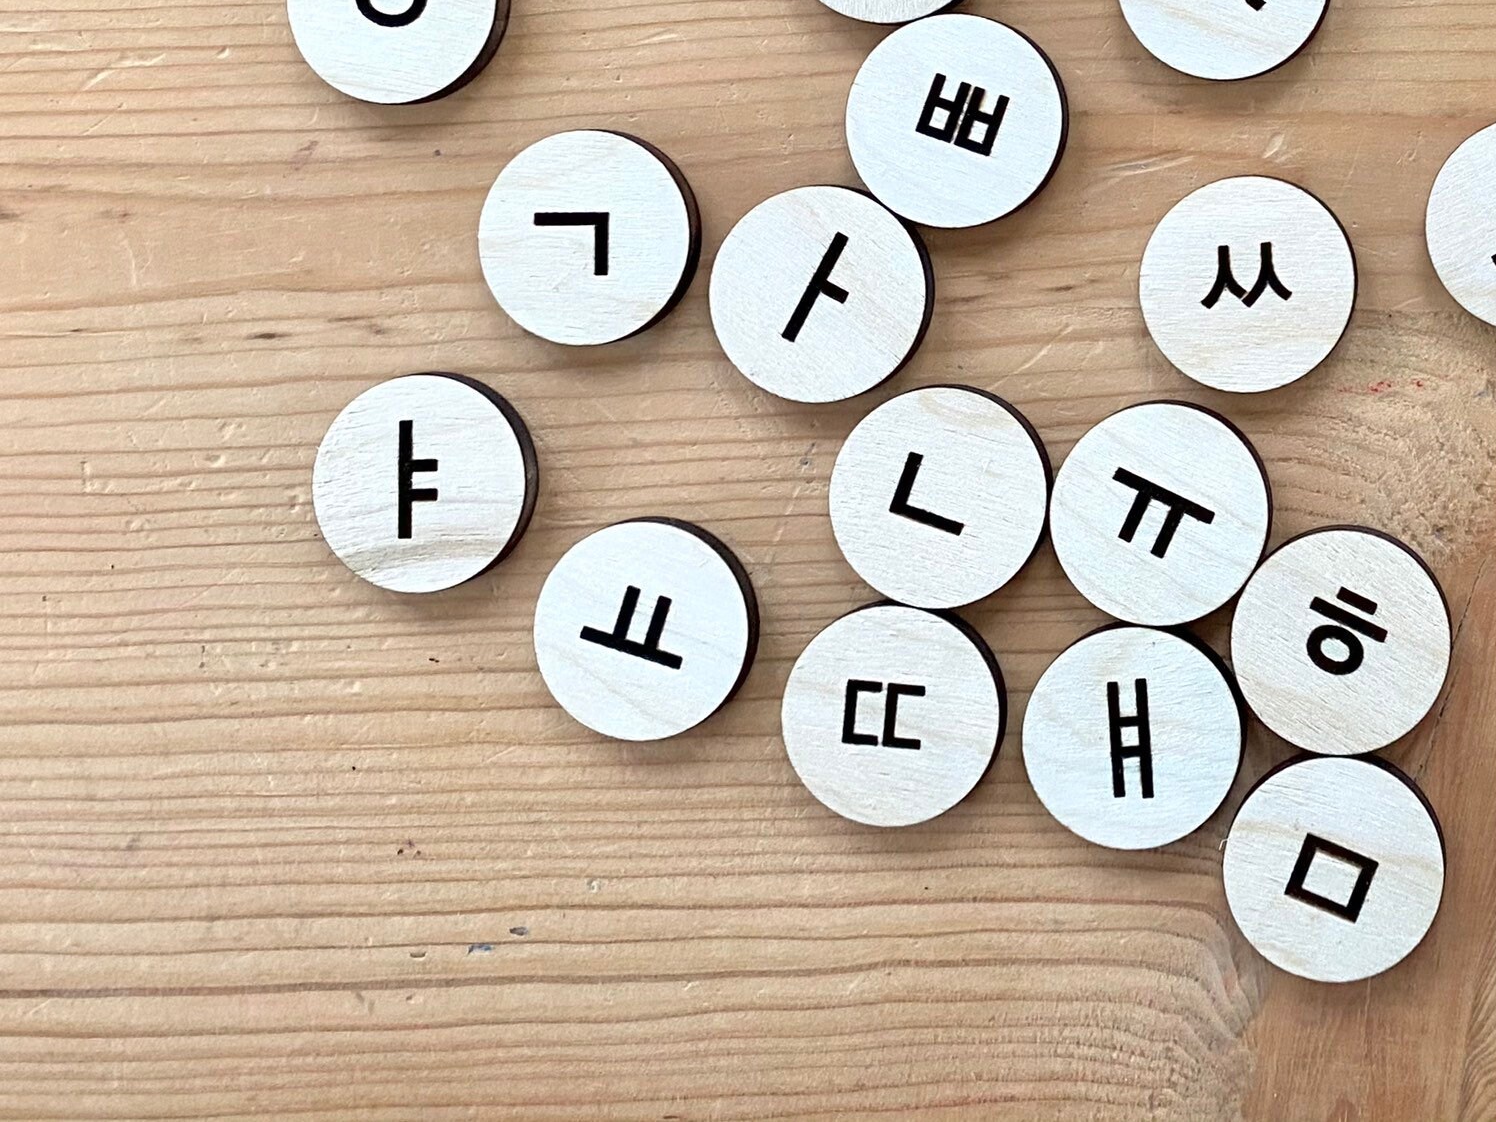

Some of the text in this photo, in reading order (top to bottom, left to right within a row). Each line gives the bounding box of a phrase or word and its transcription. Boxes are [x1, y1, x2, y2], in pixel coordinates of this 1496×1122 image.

[916, 73, 1009, 156] ㅃ
[1201, 242, 1292, 309] ㅆ
[1307, 587, 1387, 675] ㅎ
[842, 679, 925, 750] ㄸ
[1285, 833, 1379, 923] ㅁ
